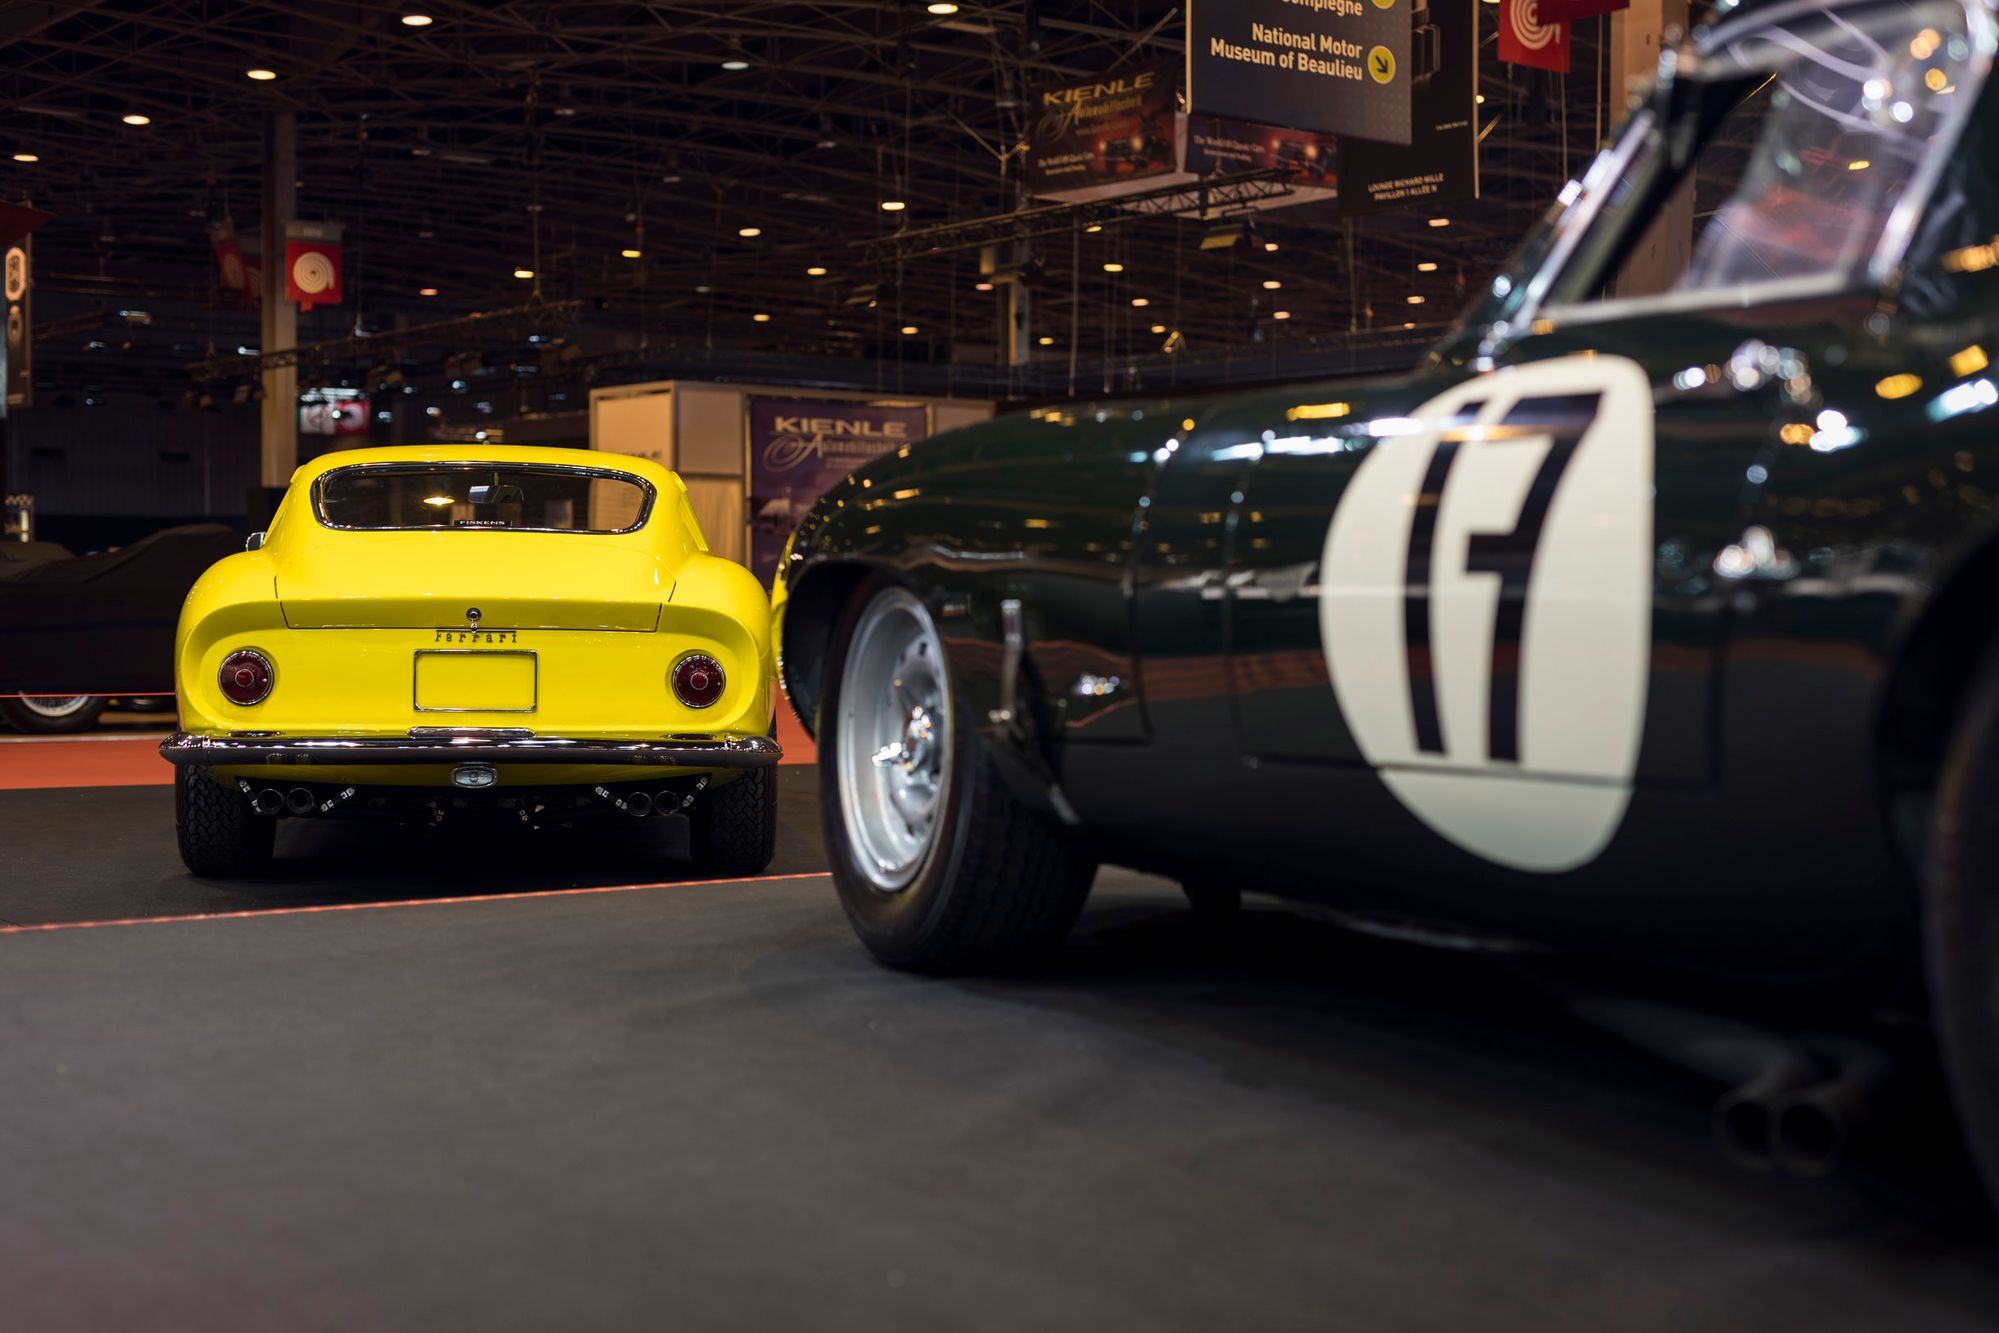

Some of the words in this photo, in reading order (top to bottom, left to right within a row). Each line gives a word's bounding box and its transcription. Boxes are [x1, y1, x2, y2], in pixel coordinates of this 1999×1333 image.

[1252, 22, 1316, 51] National
[1320, 34, 1363, 59] Motor
[1210, 37, 1276, 67] Museum
[1279, 52, 1295, 69] of
[1298, 53, 1363, 81] Beaulieu
[1043, 71, 1154, 106] KIENLE
[774, 416, 907, 439] KIENLE
[1404, 391, 1605, 764] 17
[435, 629, 517, 643] Ferrari
